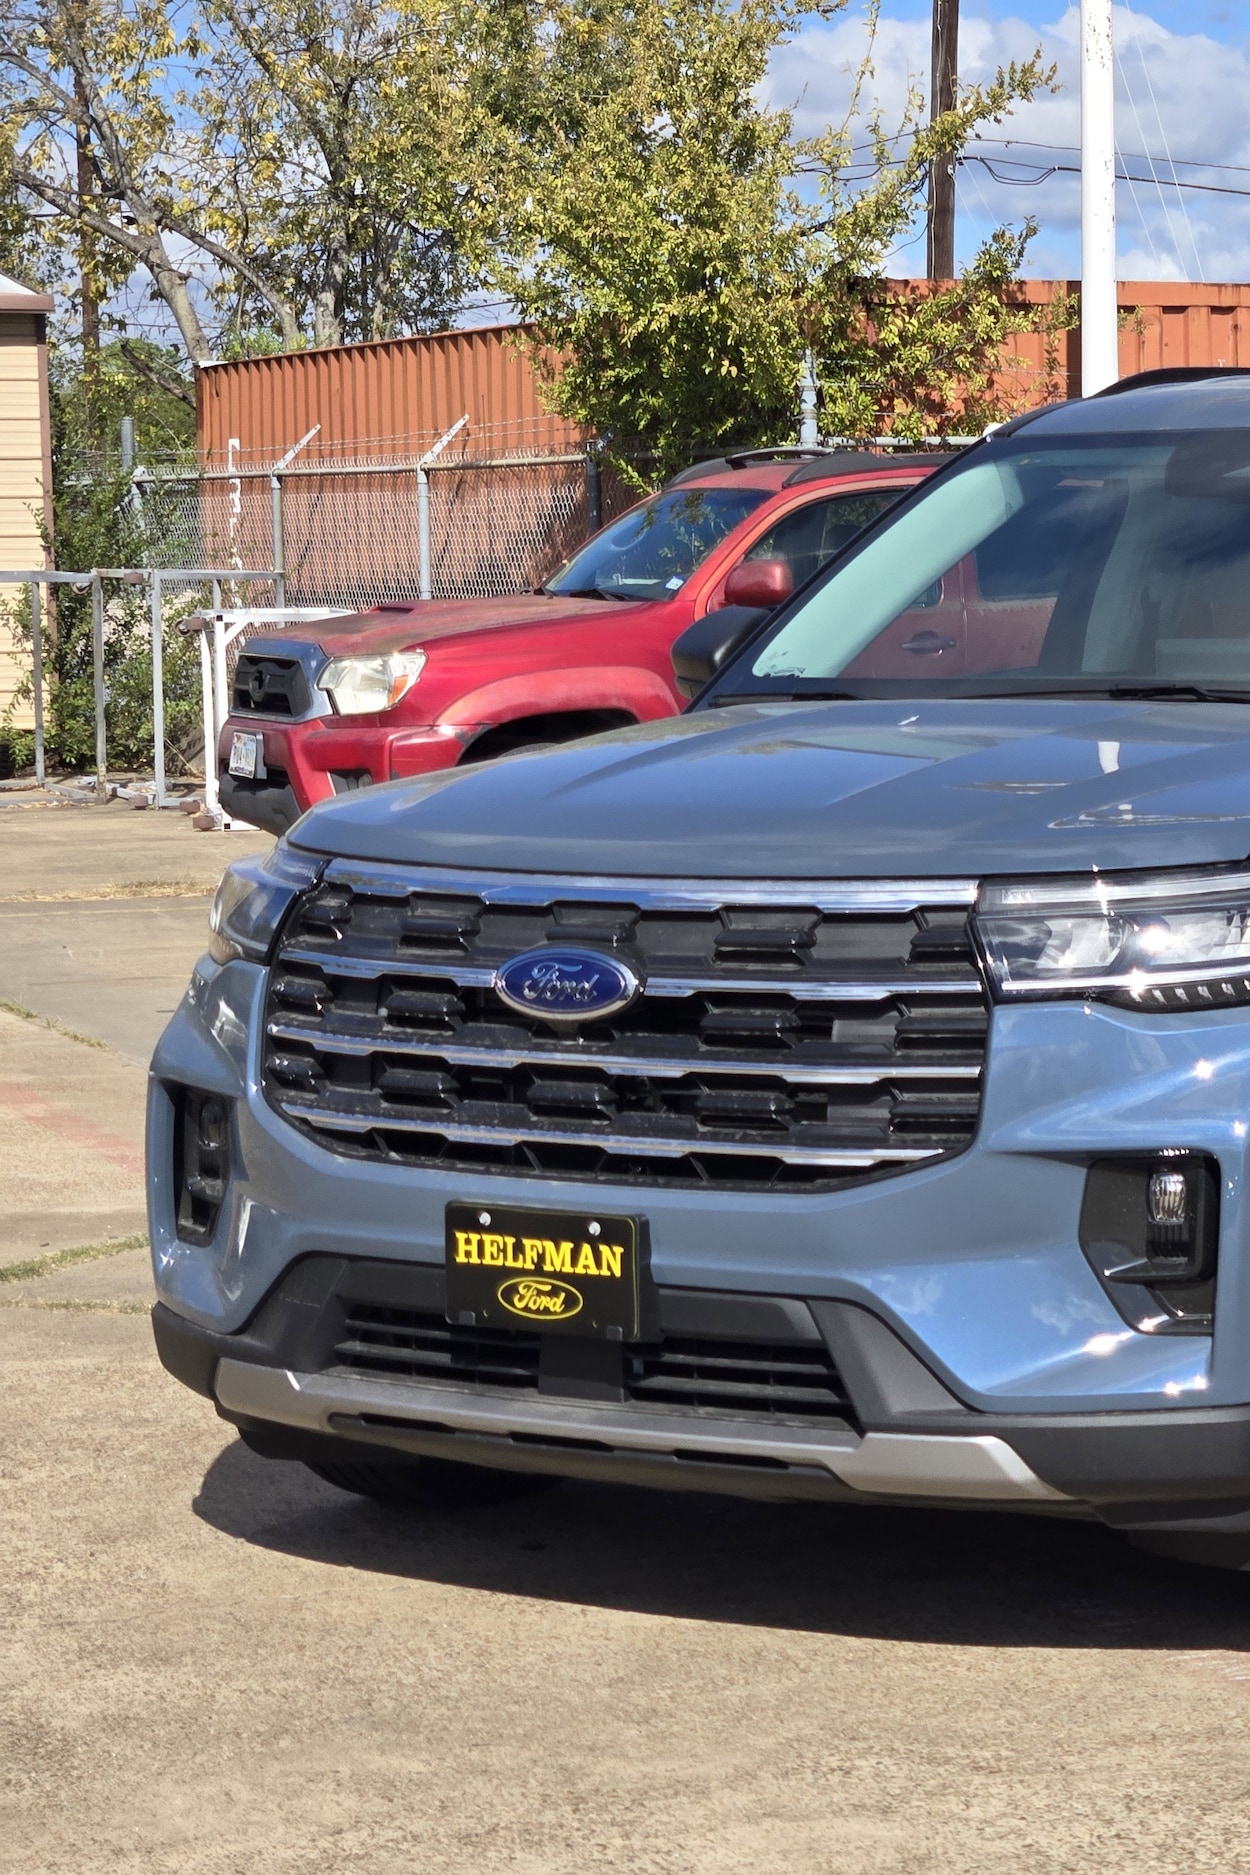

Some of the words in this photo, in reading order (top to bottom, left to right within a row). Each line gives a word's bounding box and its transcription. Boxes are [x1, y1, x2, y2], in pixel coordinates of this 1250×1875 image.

[522, 961, 600, 1003] Ford
[454, 1230, 624, 1278] HELFMAN
[513, 1281, 566, 1313] Ford
